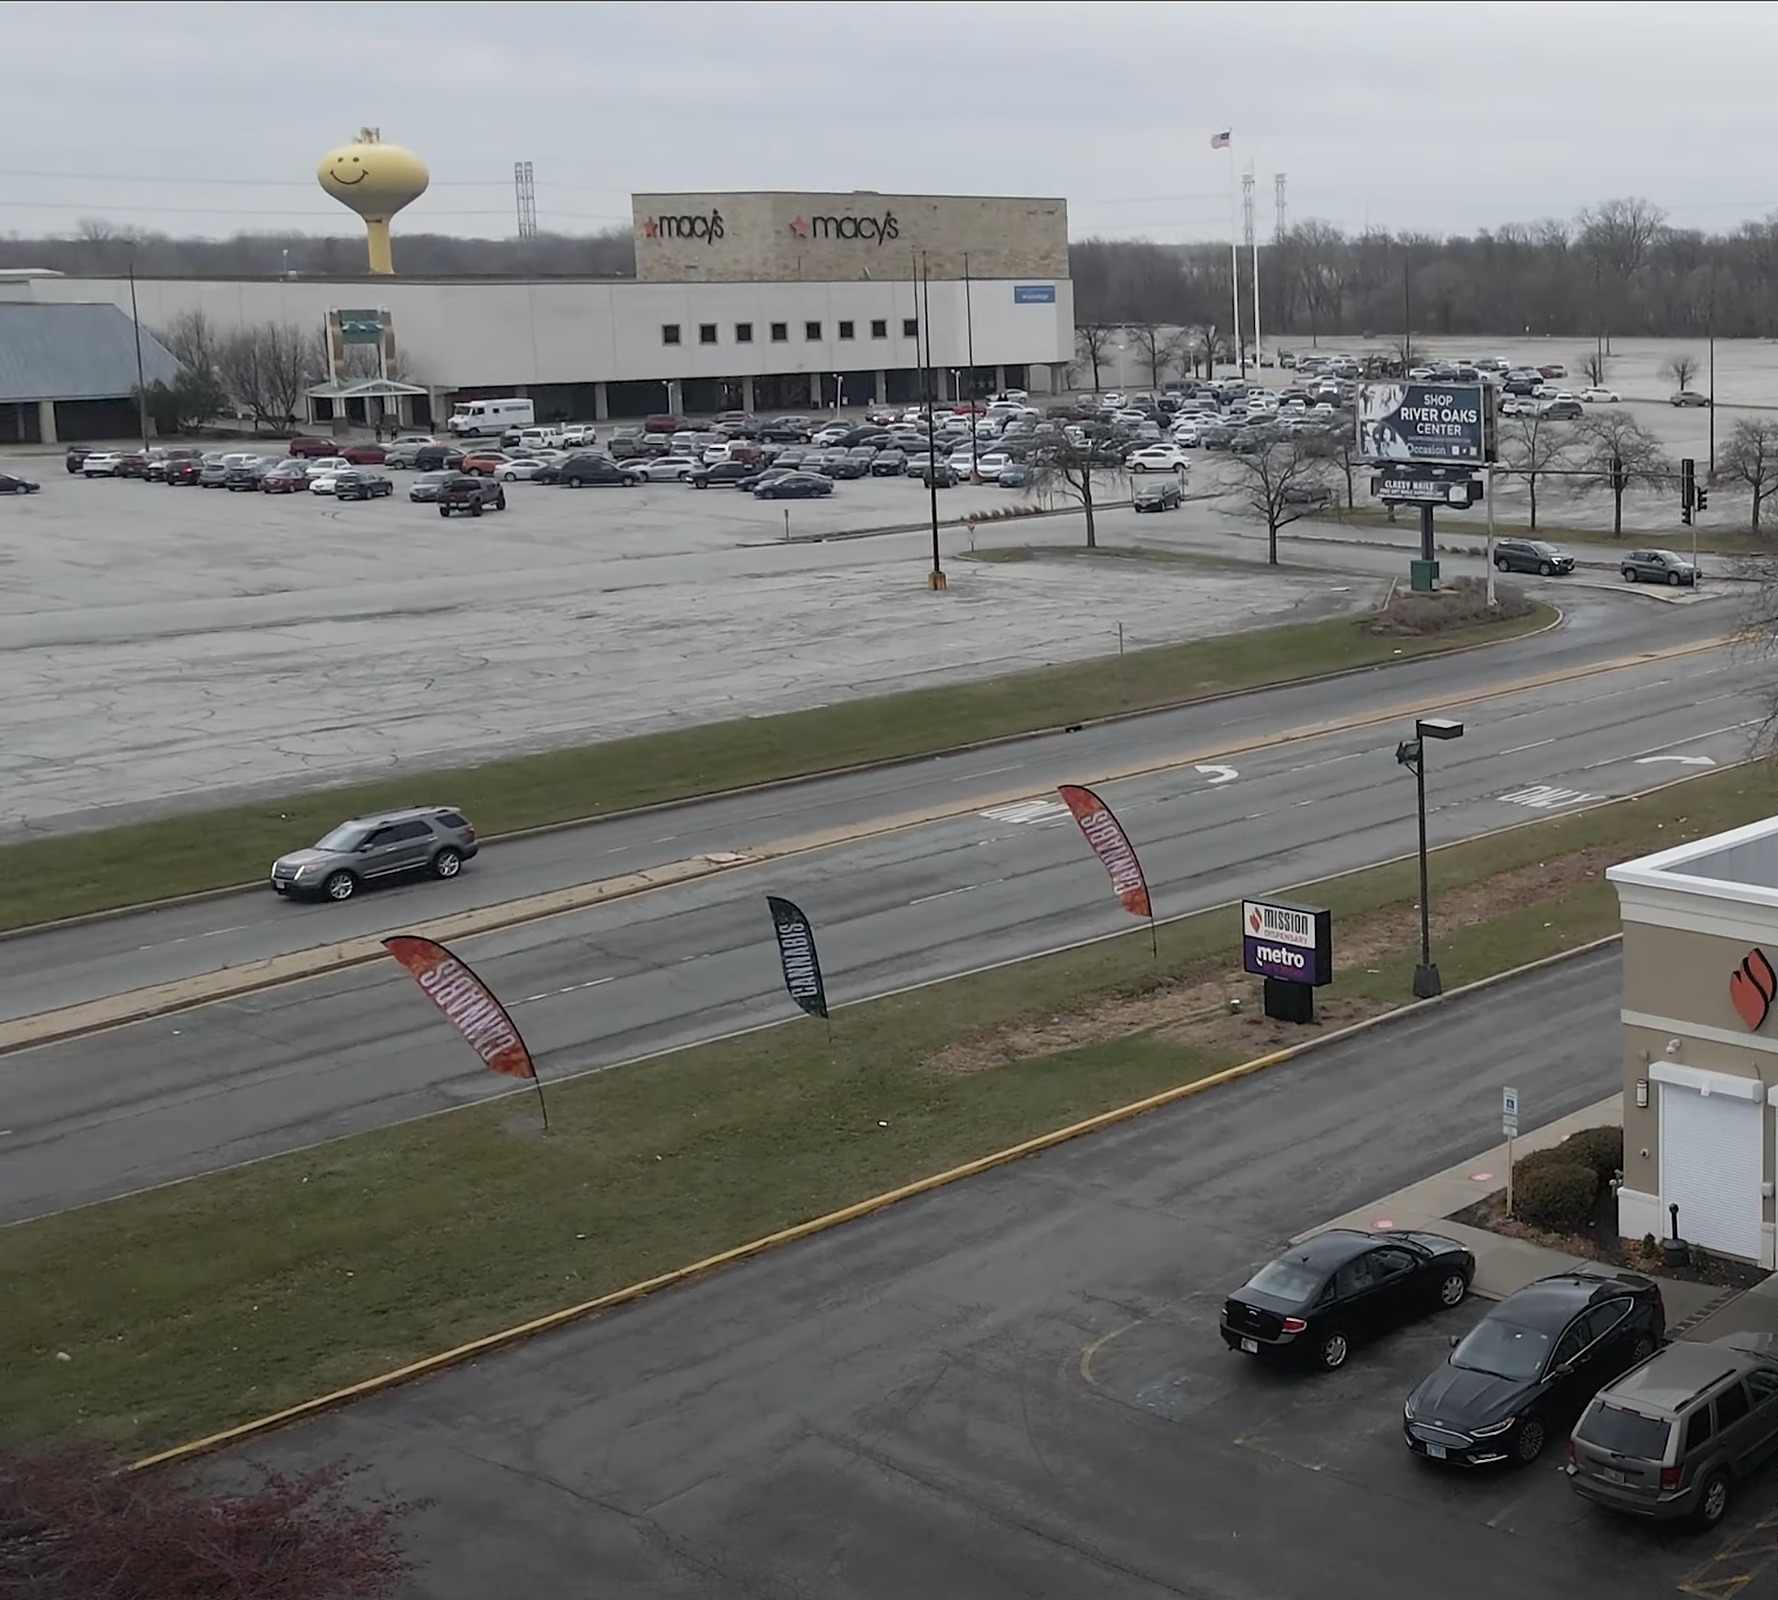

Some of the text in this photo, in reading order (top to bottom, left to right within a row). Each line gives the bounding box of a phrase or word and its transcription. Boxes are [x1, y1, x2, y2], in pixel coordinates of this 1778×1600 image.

[658, 208, 724, 246] macy's
[812, 210, 899, 246] macy's
[1401, 406, 1477, 423] RIVER OAKS
[1424, 393, 1453, 407] SHOP
[1416, 422, 1461, 436] CENTER
[1384, 479, 1411, 490] CLASSY
[1080, 809, 1141, 895] CANNABIS
[778, 922, 818, 998] CANNABIS
[1256, 945, 1305, 968] metro
[420, 958, 516, 1060] CANNABIS
